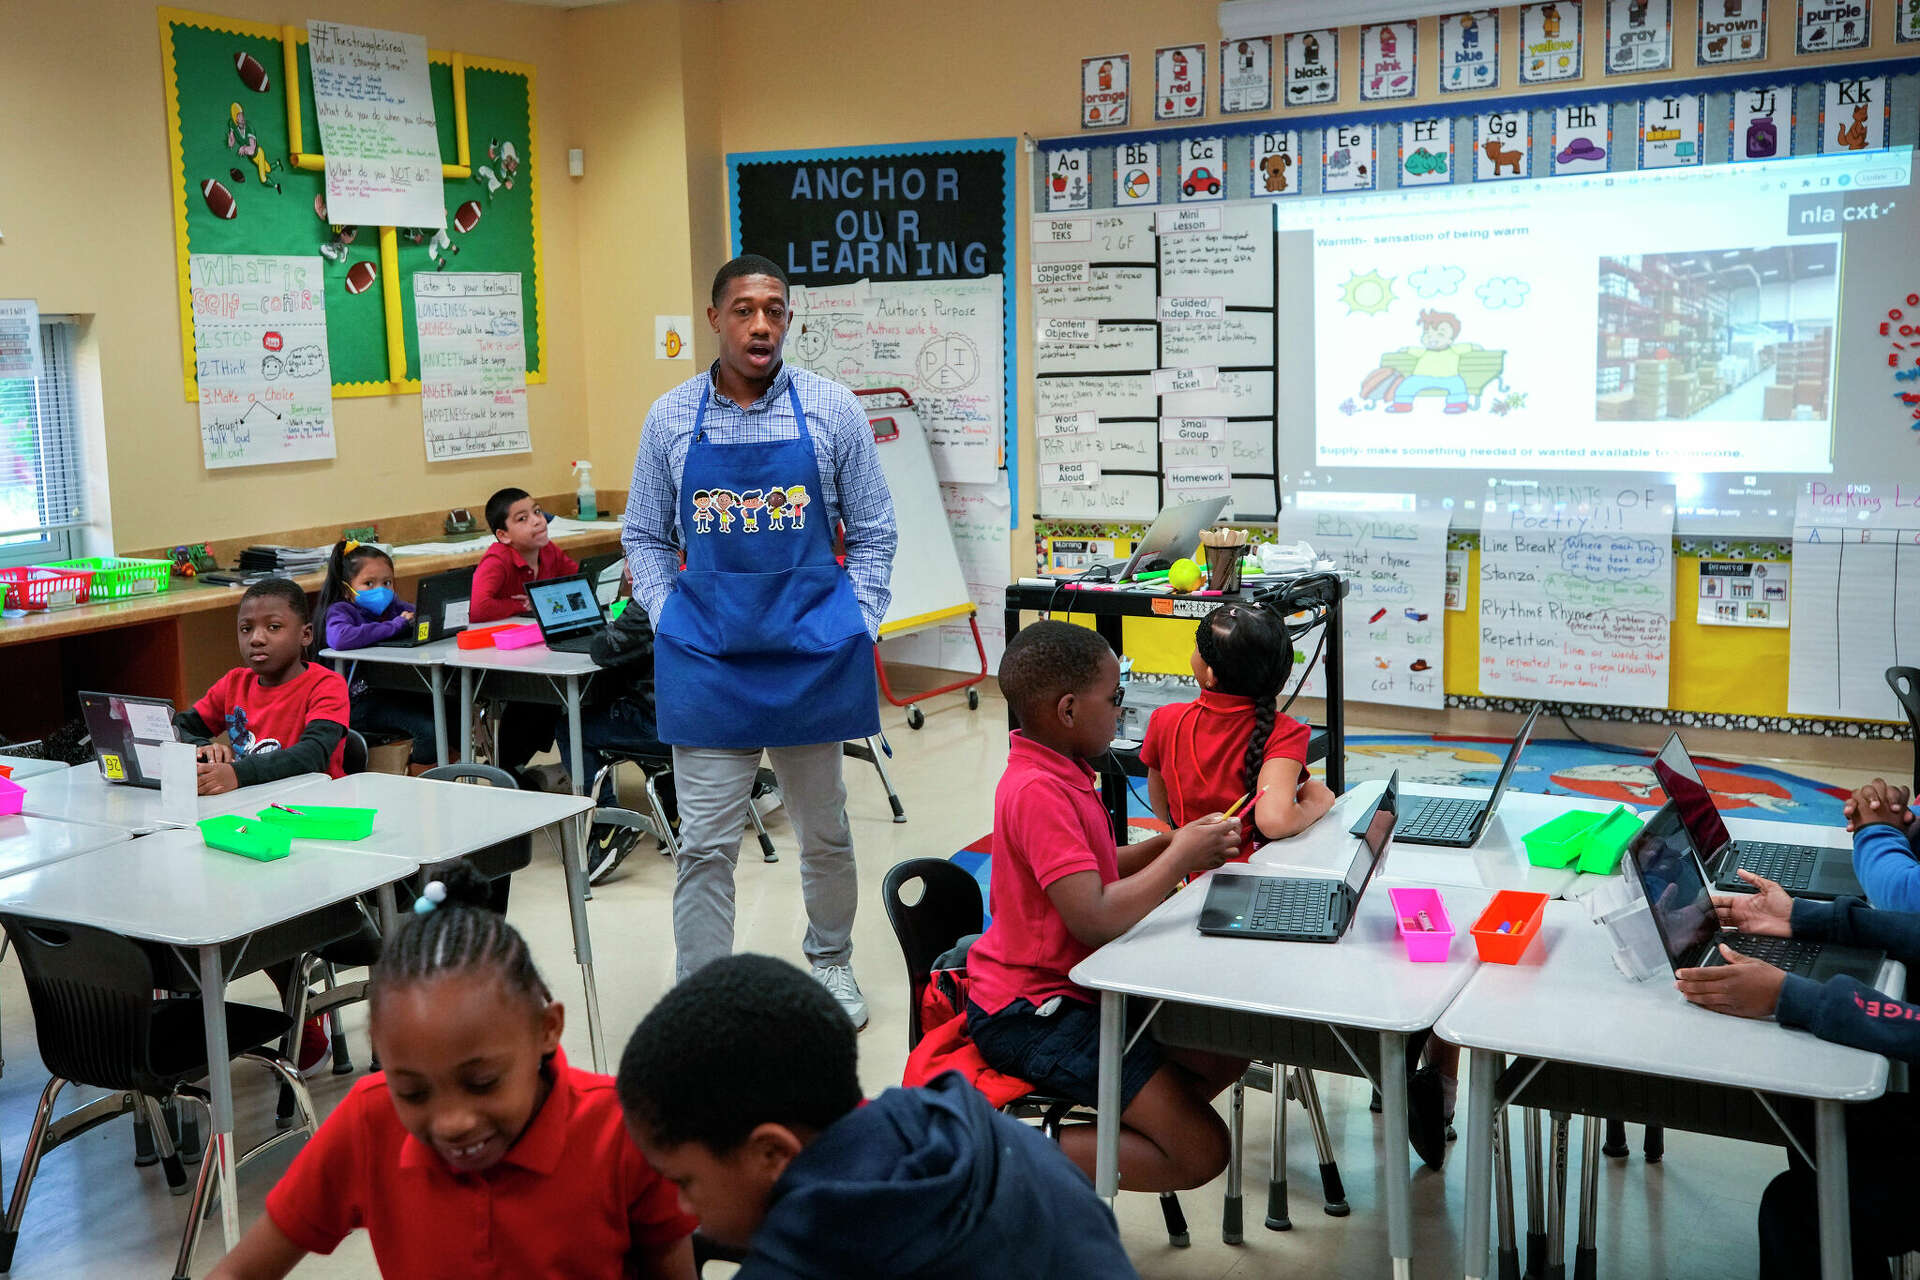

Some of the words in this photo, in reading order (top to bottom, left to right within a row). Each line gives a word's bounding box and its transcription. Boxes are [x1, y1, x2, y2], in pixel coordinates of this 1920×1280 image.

[1807, 4, 1861, 25] purple
[1706, 17, 1759, 34] brown
[1620, 30, 1656, 47] gray
[1529, 40, 1574, 57] yellow
[1456, 51, 1483, 63] blue
[1295, 65, 1328, 79] black
[1375, 59, 1402, 75] pink
[1170, 81, 1191, 94] red
[1838, 80, 1872, 104] Kk
[1086, 91, 1125, 104] orange
[1750, 90, 1776, 117] Jj
[1567, 106, 1597, 128] Hh
[1663, 99, 1680, 120] Ii
[1414, 121, 1438, 141] Ff
[1488, 114, 1517, 138] Gg
[1263, 134, 1288, 152] Dd
[1338, 128, 1360, 147] Ee
[1125, 146, 1147, 164] Bb
[1190, 141, 1213, 159] Cc
[1057, 153, 1079, 171] Aa
[791, 167, 959, 200] ANCHOR
[1179, 209, 1199, 219] Mini
[1843, 202, 1879, 221] cxt
[835, 210, 919, 242] OUR
[1051, 221, 1072, 230] Date
[1173, 221, 1206, 231] Lesson
[1052, 232, 1072, 240] TEKS
[1374, 232, 1434, 245] sensation
[1438, 230, 1450, 241] of
[1454, 228, 1490, 241] being
[1493, 226, 1529, 237] warm
[788, 240, 988, 276] LEARNING
[1037, 263, 1083, 274] Language
[1038, 273, 1083, 285] Objective
[418, 303, 468, 319] LONELINESS
[935, 298, 976, 317] Purpose
[866, 322, 900, 336] Authors
[927, 321, 939, 334] to
[1050, 319, 1086, 329] Content
[215, 330, 253, 349] STOP
[1045, 328, 1089, 340] Objective
[926, 351, 937, 372] P
[941, 369, 950, 385] E
[1177, 370, 1193, 379] Exit
[422, 385, 453, 399] ANGER
[1172, 380, 1200, 390] Ticket
[424, 408, 467, 423] HAPPINESS
[1055, 414, 1078, 424] Word
[1181, 419, 1207, 428] Small
[1055, 424, 1079, 434] Study
[1179, 429, 1209, 441] Group
[1366, 446, 1398, 455] make
[1402, 447, 1466, 458] something
[1470, 447, 1516, 457] needed
[1520, 449, 1534, 457] or
[1538, 448, 1585, 457] wanted
[1590, 448, 1650, 457] available
[1059, 464, 1082, 473] Read
[1058, 473, 1085, 483] Aloud
[1172, 473, 1224, 483] Homework
[1812, 481, 1881, 513] Parking
[1847, 484, 1871, 494] END
[1616, 488, 1656, 511] OF
[1315, 513, 1419, 547] Rhymes
[1808, 527, 1821, 544] A
[1861, 529, 1871, 544] B
[1482, 536, 1508, 552] Line
[1344, 548, 1368, 565] that
[1380, 552, 1411, 569] rhyme
[1372, 583, 1409, 595] sounds
[1370, 628, 1388, 641] red
[1371, 676, 1394, 692] cat
[1410, 676, 1435, 692] hat
